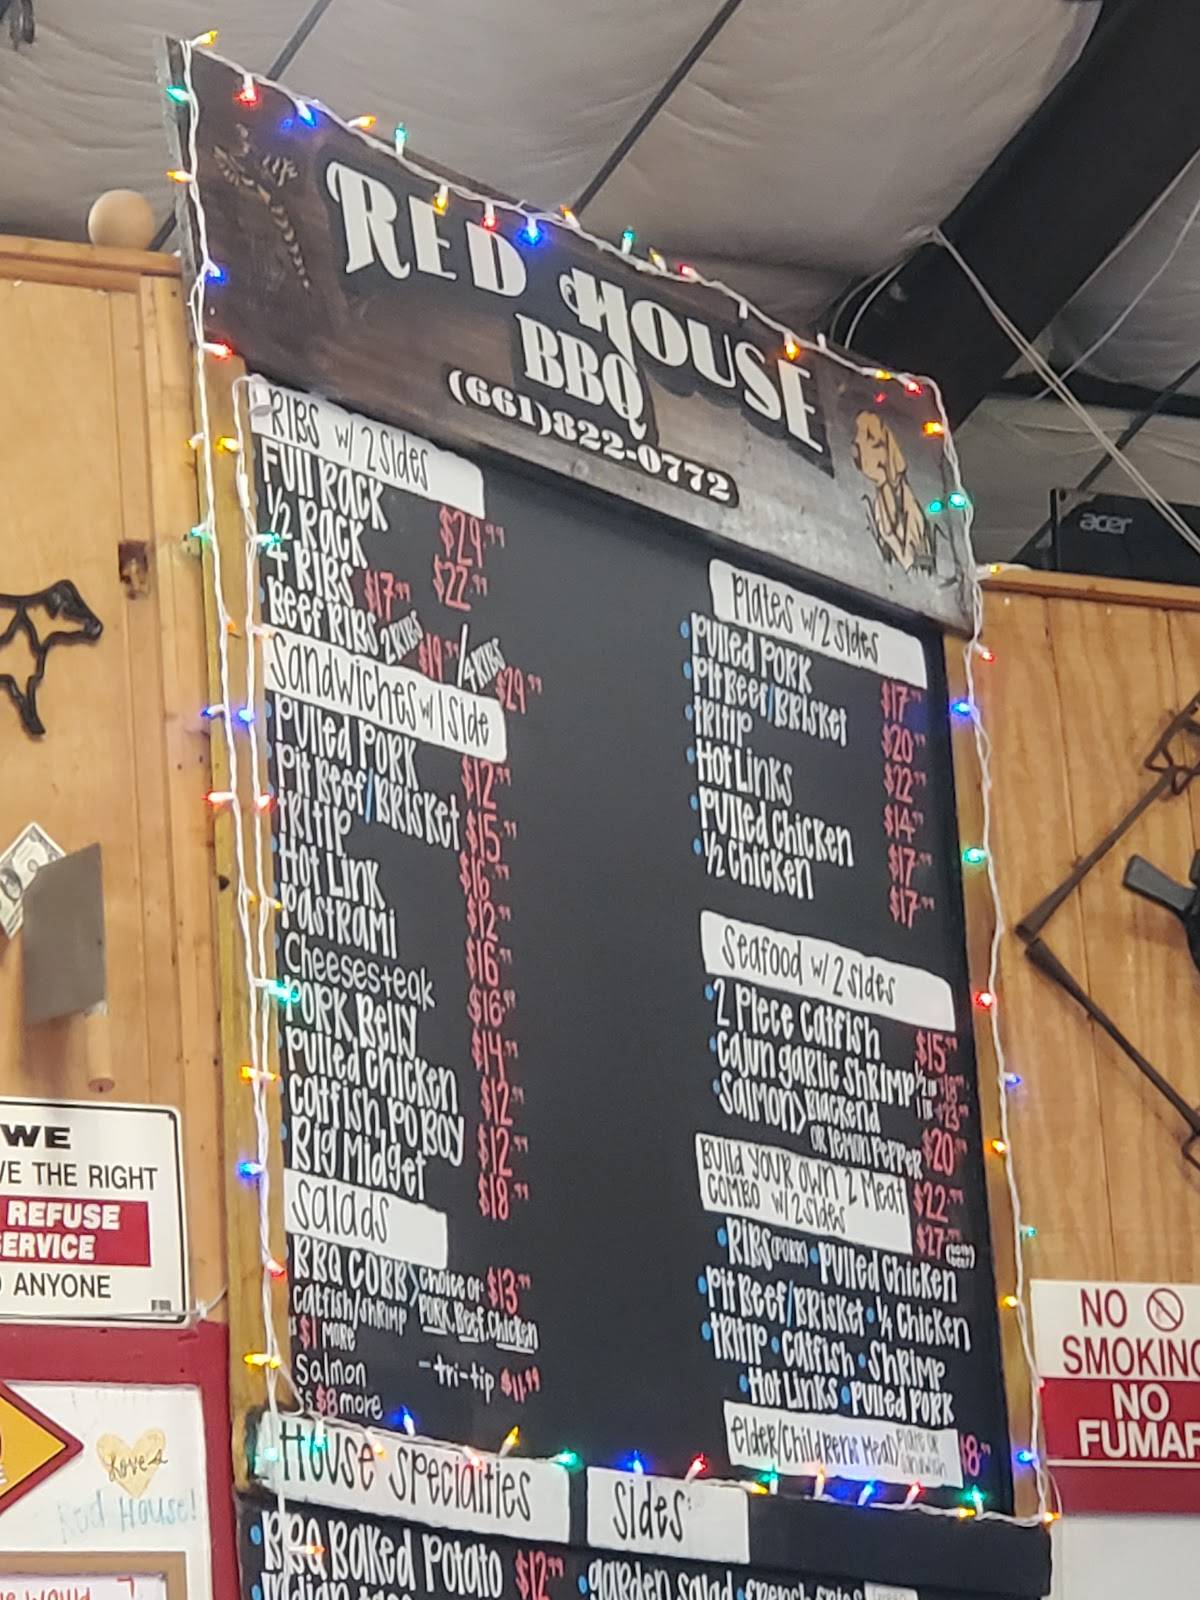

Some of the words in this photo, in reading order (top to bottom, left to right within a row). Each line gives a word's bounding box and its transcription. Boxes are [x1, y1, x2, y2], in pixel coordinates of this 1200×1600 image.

[326, 161, 528, 298] RED
[558, 267, 825, 454] HOUSE
[514, 312, 648, 442] BBQ
[269, 388, 320, 449] RIBS
[335, 420, 353, 463] w/
[362, 426, 376, 472] 2
[448, 368, 732, 503] (661)822-0772
[440, 505, 505, 569] $29.99
[1079, 512, 1133, 535] acer
[266, 540, 288, 581] 4
[433, 554, 488, 612] $22.99
[731, 572, 794, 635] Plates
[271, 631, 416, 732] Sandwiches
[284, 931, 436, 1012] Cheesesteak
[467, 983, 516, 1028] $16.99
[722, 924, 803, 986] Seafood
[713, 977, 730, 1028] 2
[0, 1123, 72, 1150] WE
[32, 1161, 78, 1187] THE
[89, 1164, 158, 1191] RIGHT
[478, 1171, 529, 1221] $18.99
[7, 1199, 121, 1231] REFUSE
[0, 1230, 96, 1261] ERVICE
[292, 1233, 343, 1286] BBQ
[13, 1272, 112, 1300] ANYONE
[486, 1266, 532, 1315] $13.99
[1080, 1287, 1128, 1328] NO
[299, 1314, 318, 1351] $1
[296, 1351, 367, 1389] Salmon
[500, 1367, 541, 1404] $11.99
[315, 1383, 339, 1417] $8
[340, 1391, 384, 1421] more
[1111, 1382, 1170, 1422] NO
[280, 1421, 375, 1492] House
[389, 1446, 531, 1522] Specialties
